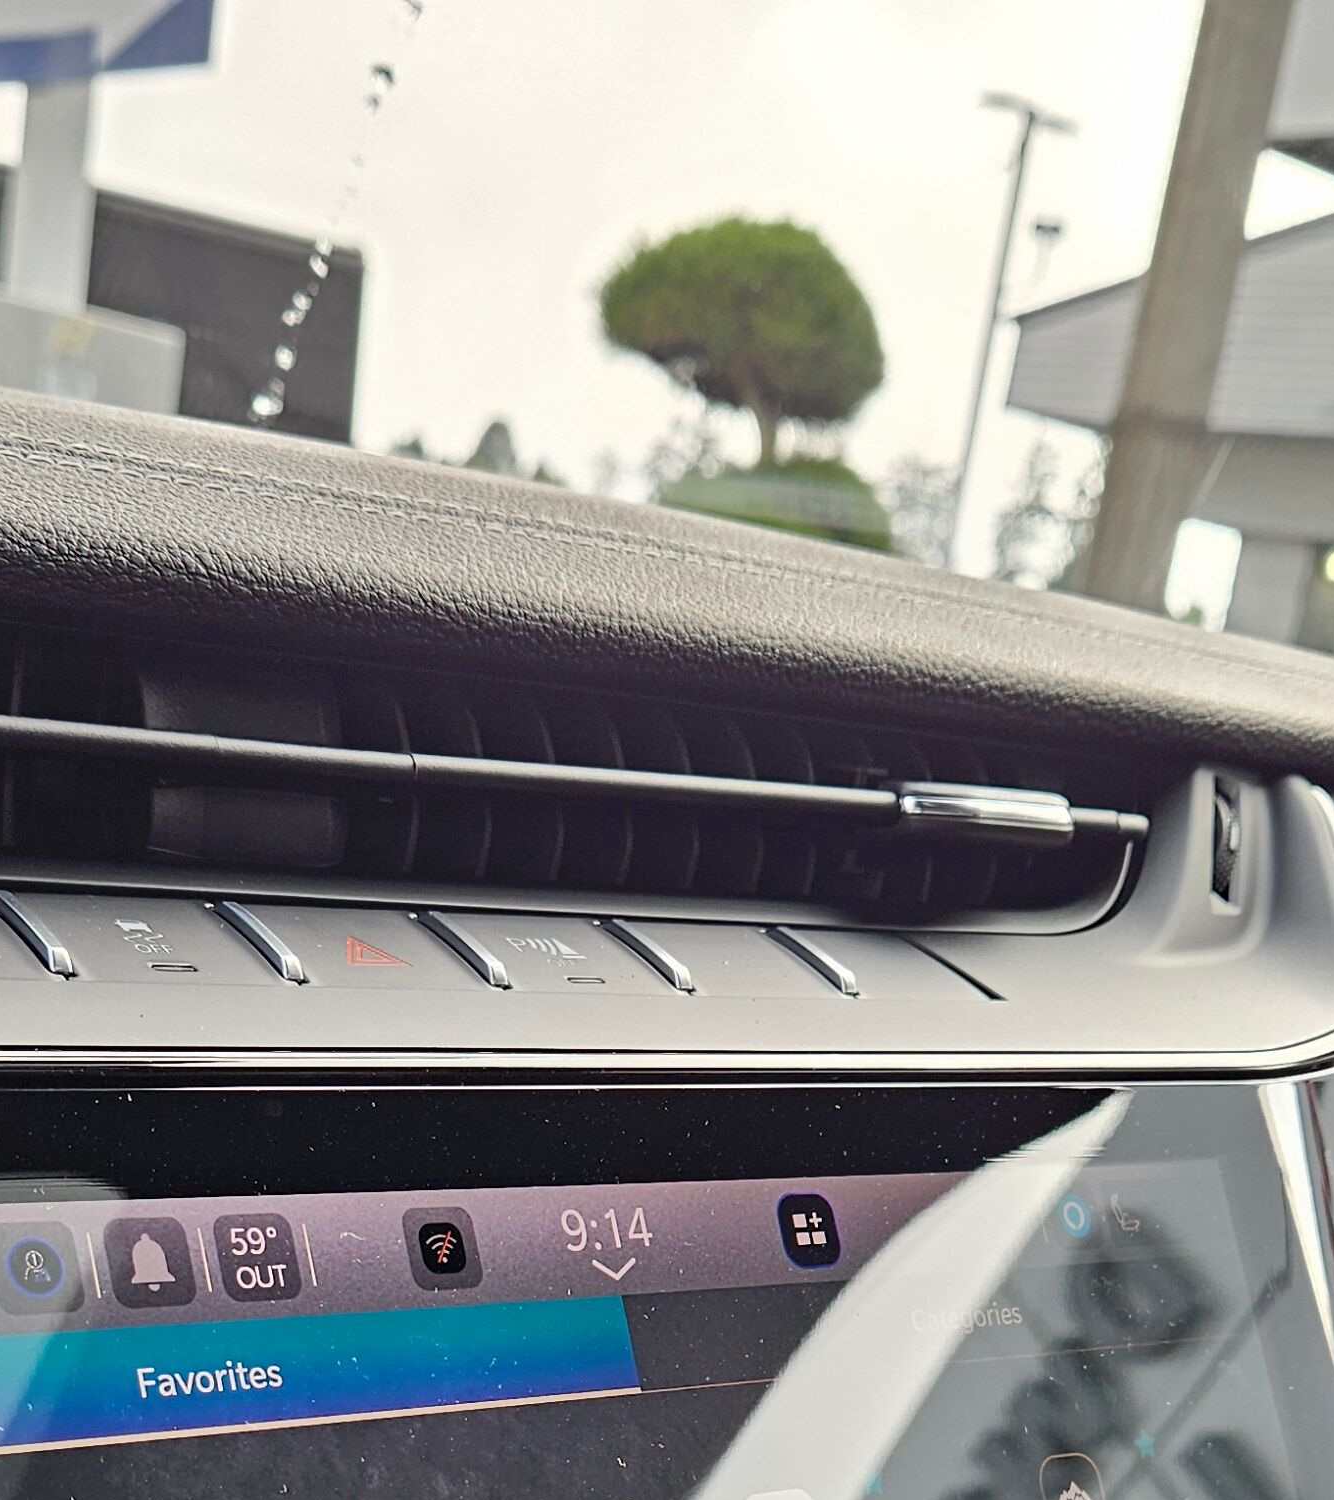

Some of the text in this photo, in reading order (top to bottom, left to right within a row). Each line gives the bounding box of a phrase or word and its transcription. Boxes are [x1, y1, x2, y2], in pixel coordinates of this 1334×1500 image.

[134, 944, 173, 955] OFF
[561, 1206, 653, 1251] 9:14
[236, 1264, 286, 1291] OUT
[911, 1301, 1023, 1334] Categories
[137, 1360, 283, 1398] Favorites
